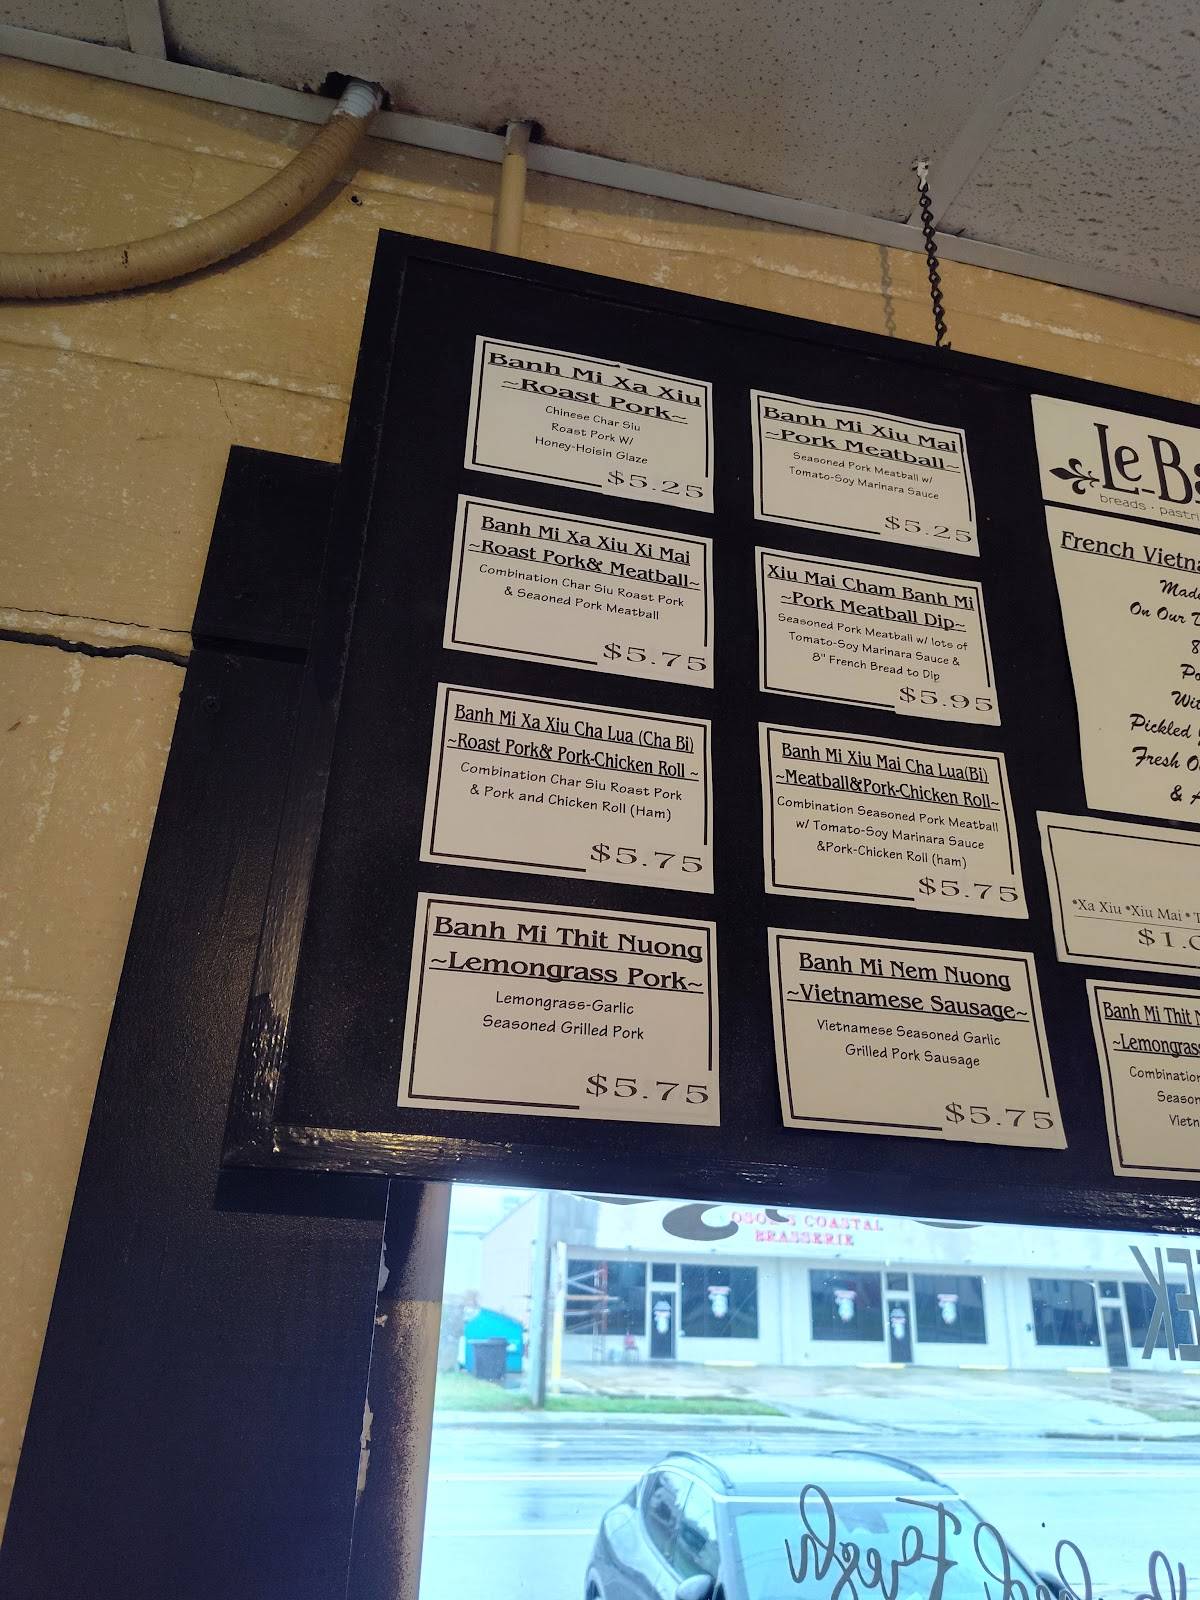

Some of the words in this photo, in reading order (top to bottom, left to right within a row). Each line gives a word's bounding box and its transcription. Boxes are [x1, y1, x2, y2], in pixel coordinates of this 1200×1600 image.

[488, 352, 560, 376] Banh
[613, 376, 648, 394] Xa
[659, 387, 702, 407] Xiu
[545, 406, 590, 422] Chinese
[593, 414, 619, 426] Char
[622, 420, 641, 431] Siu
[551, 422, 587, 437] Roast
[590, 428, 616, 444] Pork
[763, 406, 825, 426] Banh
[872, 424, 907, 442] Xiu
[918, 435, 958, 452] Mai
[535, 436, 612, 458] Honey-Hoisin
[616, 451, 648, 465] Glaze
[793, 452, 845, 468] Seasoned
[849, 461, 871, 474] Pork
[874, 466, 918, 483] Meatball
[607, 470, 704, 499] $5.25
[789, 466, 854, 486] Tomato-Soy
[858, 477, 904, 494] Marinara
[907, 487, 939, 500] Sauce
[1100, 494, 1146, 510] breads
[481, 515, 531, 535] Banh
[567, 531, 591, 546] Xa
[599, 536, 628, 553] Xiu
[635, 544, 653, 558] Xi
[660, 546, 691, 565] Mai
[884, 516, 972, 543] $5.25
[1061, 531, 1134, 558] French
[543, 550, 603, 572] Pork&
[479, 564, 558, 586] Combination
[562, 577, 591, 591] Char
[594, 582, 613, 595] Siu
[618, 587, 655, 602] Roast
[657, 593, 684, 607] Pork
[767, 564, 798, 582] Xiu
[805, 571, 836, 588] Mai
[843, 577, 895, 598] Cham
[902, 586, 947, 607] Banh
[517, 588, 572, 606] Seaoned
[575, 598, 602, 612] Pork
[606, 603, 659, 620] Meatball
[841, 600, 917, 623] Meatball
[1129, 602, 1151, 617] On
[1157, 607, 1186, 623] Our
[778, 613, 833, 631] Seasoned
[837, 622, 861, 635] Pork
[865, 627, 913, 643] Meatball
[931, 637, 953, 649] lots
[957, 641, 968, 651] of
[603, 642, 707, 672] $5.75
[789, 632, 859, 652] Tomato-Soy
[862, 643, 911, 659] Marinara
[915, 651, 949, 666] Sauce
[812, 652, 826, 662] 8"
[829, 655, 867, 669] French
[870, 662, 903, 674] Bread
[923, 669, 940, 682] Dip
[899, 686, 992, 712] $5.95
[454, 704, 493, 724] Banh
[522, 712, 540, 730] Xa
[546, 716, 570, 734] Xiu
[574, 721, 602, 738] Cha
[608, 726, 633, 743] Lua
[638, 730, 671, 750] (Cha
[675, 734, 694, 752] Bi)
[1129, 714, 1191, 738] Pickled
[505, 739, 552, 759] Pork&
[558, 746, 653, 773] Pork-Chicken
[658, 759, 685, 778] Roll
[782, 742, 820, 761] Banh
[848, 751, 871, 766] Xiu
[877, 754, 900, 770] Mai
[906, 759, 932, 776] Cha
[937, 763, 989, 783] Lua(Bi)
[1132, 746, 1180, 768] Fresh
[460, 762, 546, 783] Combination
[550, 774, 581, 787] Char
[585, 778, 606, 792] Siu
[611, 782, 649, 796] Roast
[654, 787, 682, 800] Pork
[485, 786, 514, 800] Pork
[518, 792, 544, 803] and
[548, 794, 598, 810] Chicken
[602, 801, 626, 814] Roll
[630, 804, 672, 822] (Ham)
[777, 796, 854, 814] Combination
[857, 806, 915, 822] Seasoned
[919, 813, 945, 826] Pork
[949, 817, 998, 832] Meatball
[814, 820, 888, 840] Tomato-Soy
[892, 830, 945, 845] Marinara
[949, 836, 984, 849] Sauce
[590, 842, 702, 872] $5.75
[817, 841, 903, 860] &Pork-Chicken
[907, 852, 927, 863] Roll
[932, 853, 966, 869] (ham)
[919, 876, 1018, 902] $5.75
[1100, 902, 1122, 914] Xiu
[1158, 909, 1182, 921] Mai
[433, 916, 505, 940] Banh
[556, 927, 608, 949] Thit
[618, 934, 703, 962] Nuong
[800, 952, 852, 972] Banh
[890, 961, 938, 980] Nem
[944, 966, 1011, 991] Nuong
[496, 990, 634, 1015] Lemongrass-Garlic
[1103, 1001, 1140, 1021] Banh
[1164, 1007, 1190, 1024] Thit
[482, 1015, 556, 1033] Seasoned
[561, 1021, 607, 1037] Grilled
[613, 1026, 644, 1040] Pork
[817, 1019, 892, 1036] Vietnamese
[896, 1026, 959, 1042] Seasoned
[963, 1032, 1000, 1046] Garlic
[846, 1044, 888, 1058] Grilled
[892, 1048, 920, 1062] Pork
[924, 1051, 980, 1068] Sausage
[1113, 1033, 1200, 1058] ~Lemongras
[586, 1073, 709, 1105] $5.75
[945, 1102, 1053, 1130] $5.75
[1169, 1115, 1200, 1127] Vietn
[756, 1230, 854, 1246] BRASSERIE
[804, 1216, 883, 1231] COASTAL
